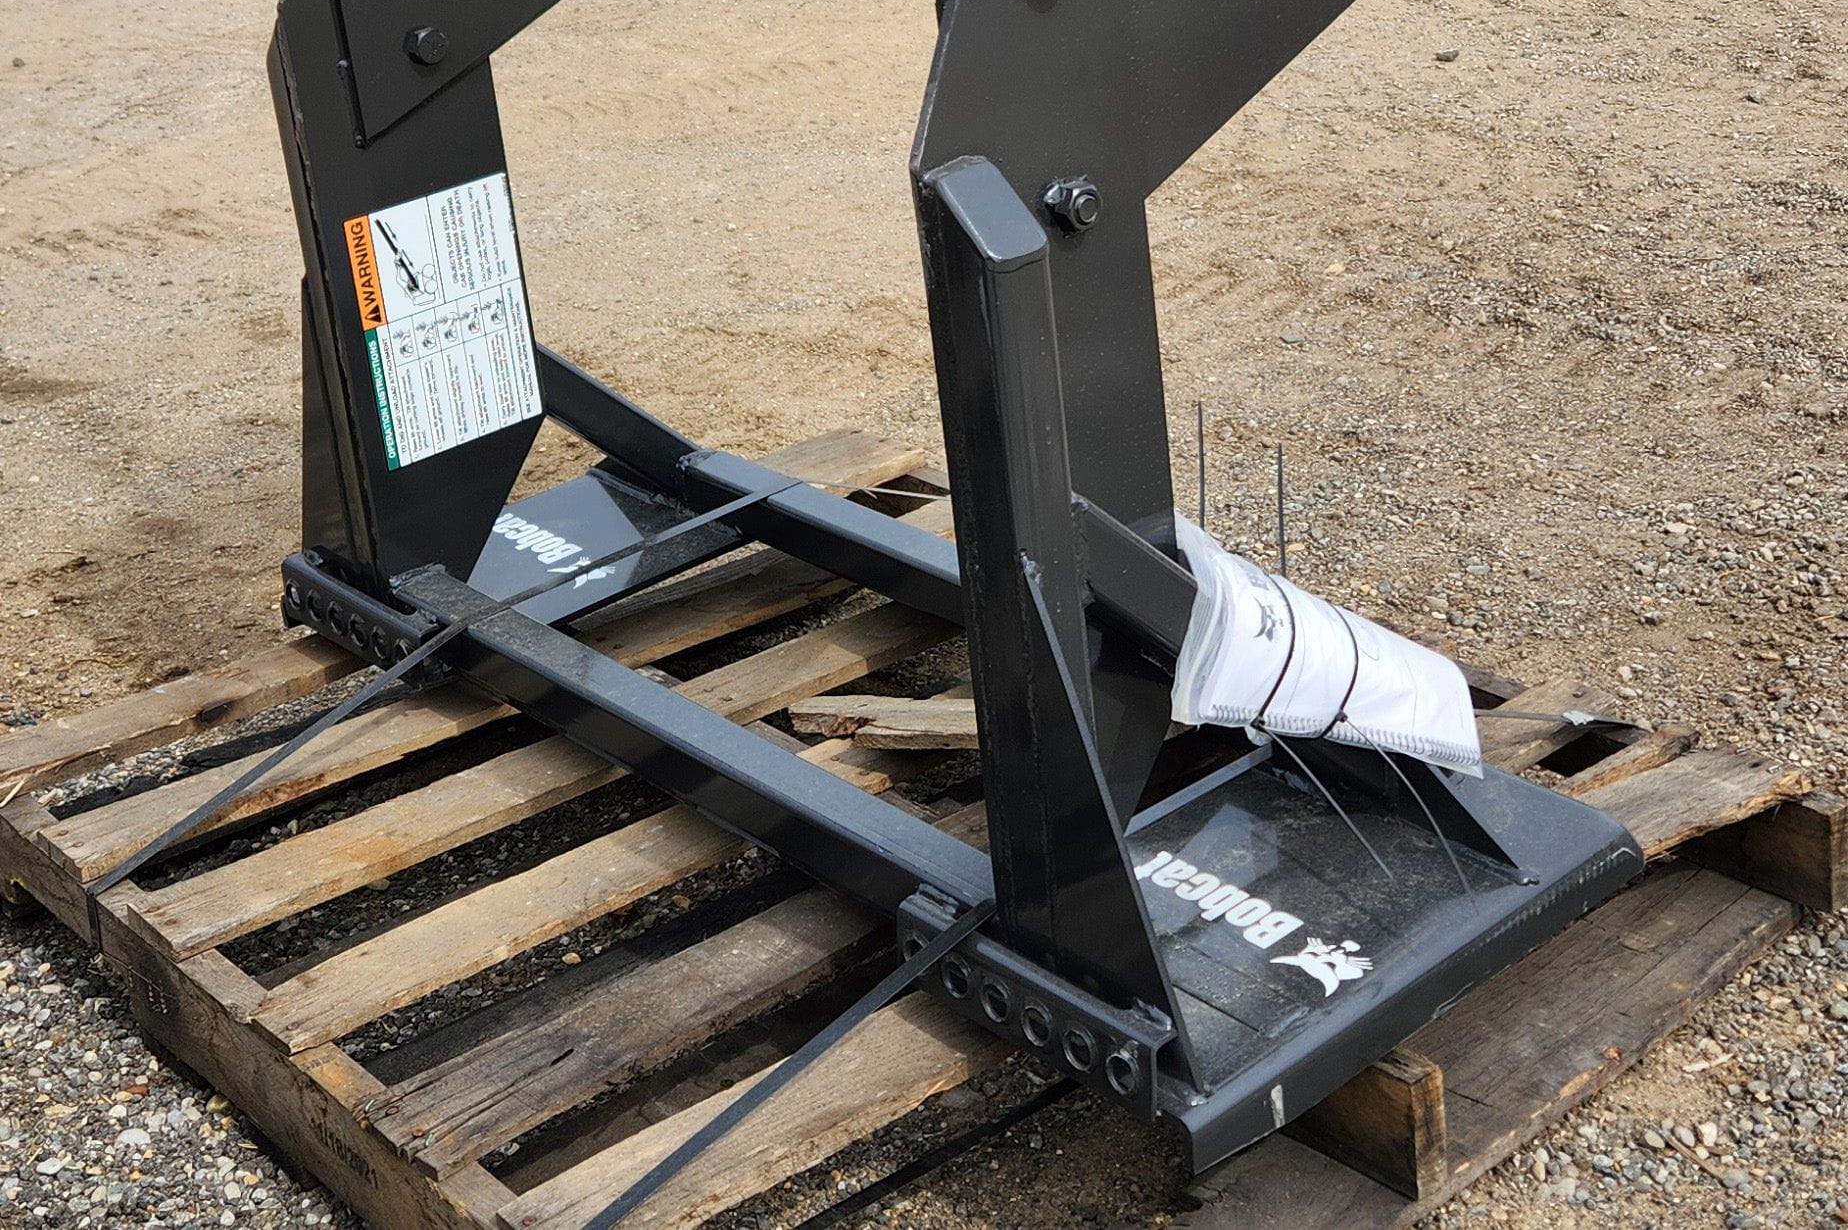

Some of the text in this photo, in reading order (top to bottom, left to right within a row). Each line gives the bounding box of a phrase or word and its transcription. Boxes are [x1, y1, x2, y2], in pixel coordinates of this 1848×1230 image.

[348, 219, 378, 307] WARNING
[367, 339, 397, 459] OPERATION INSTRUCTIONS
